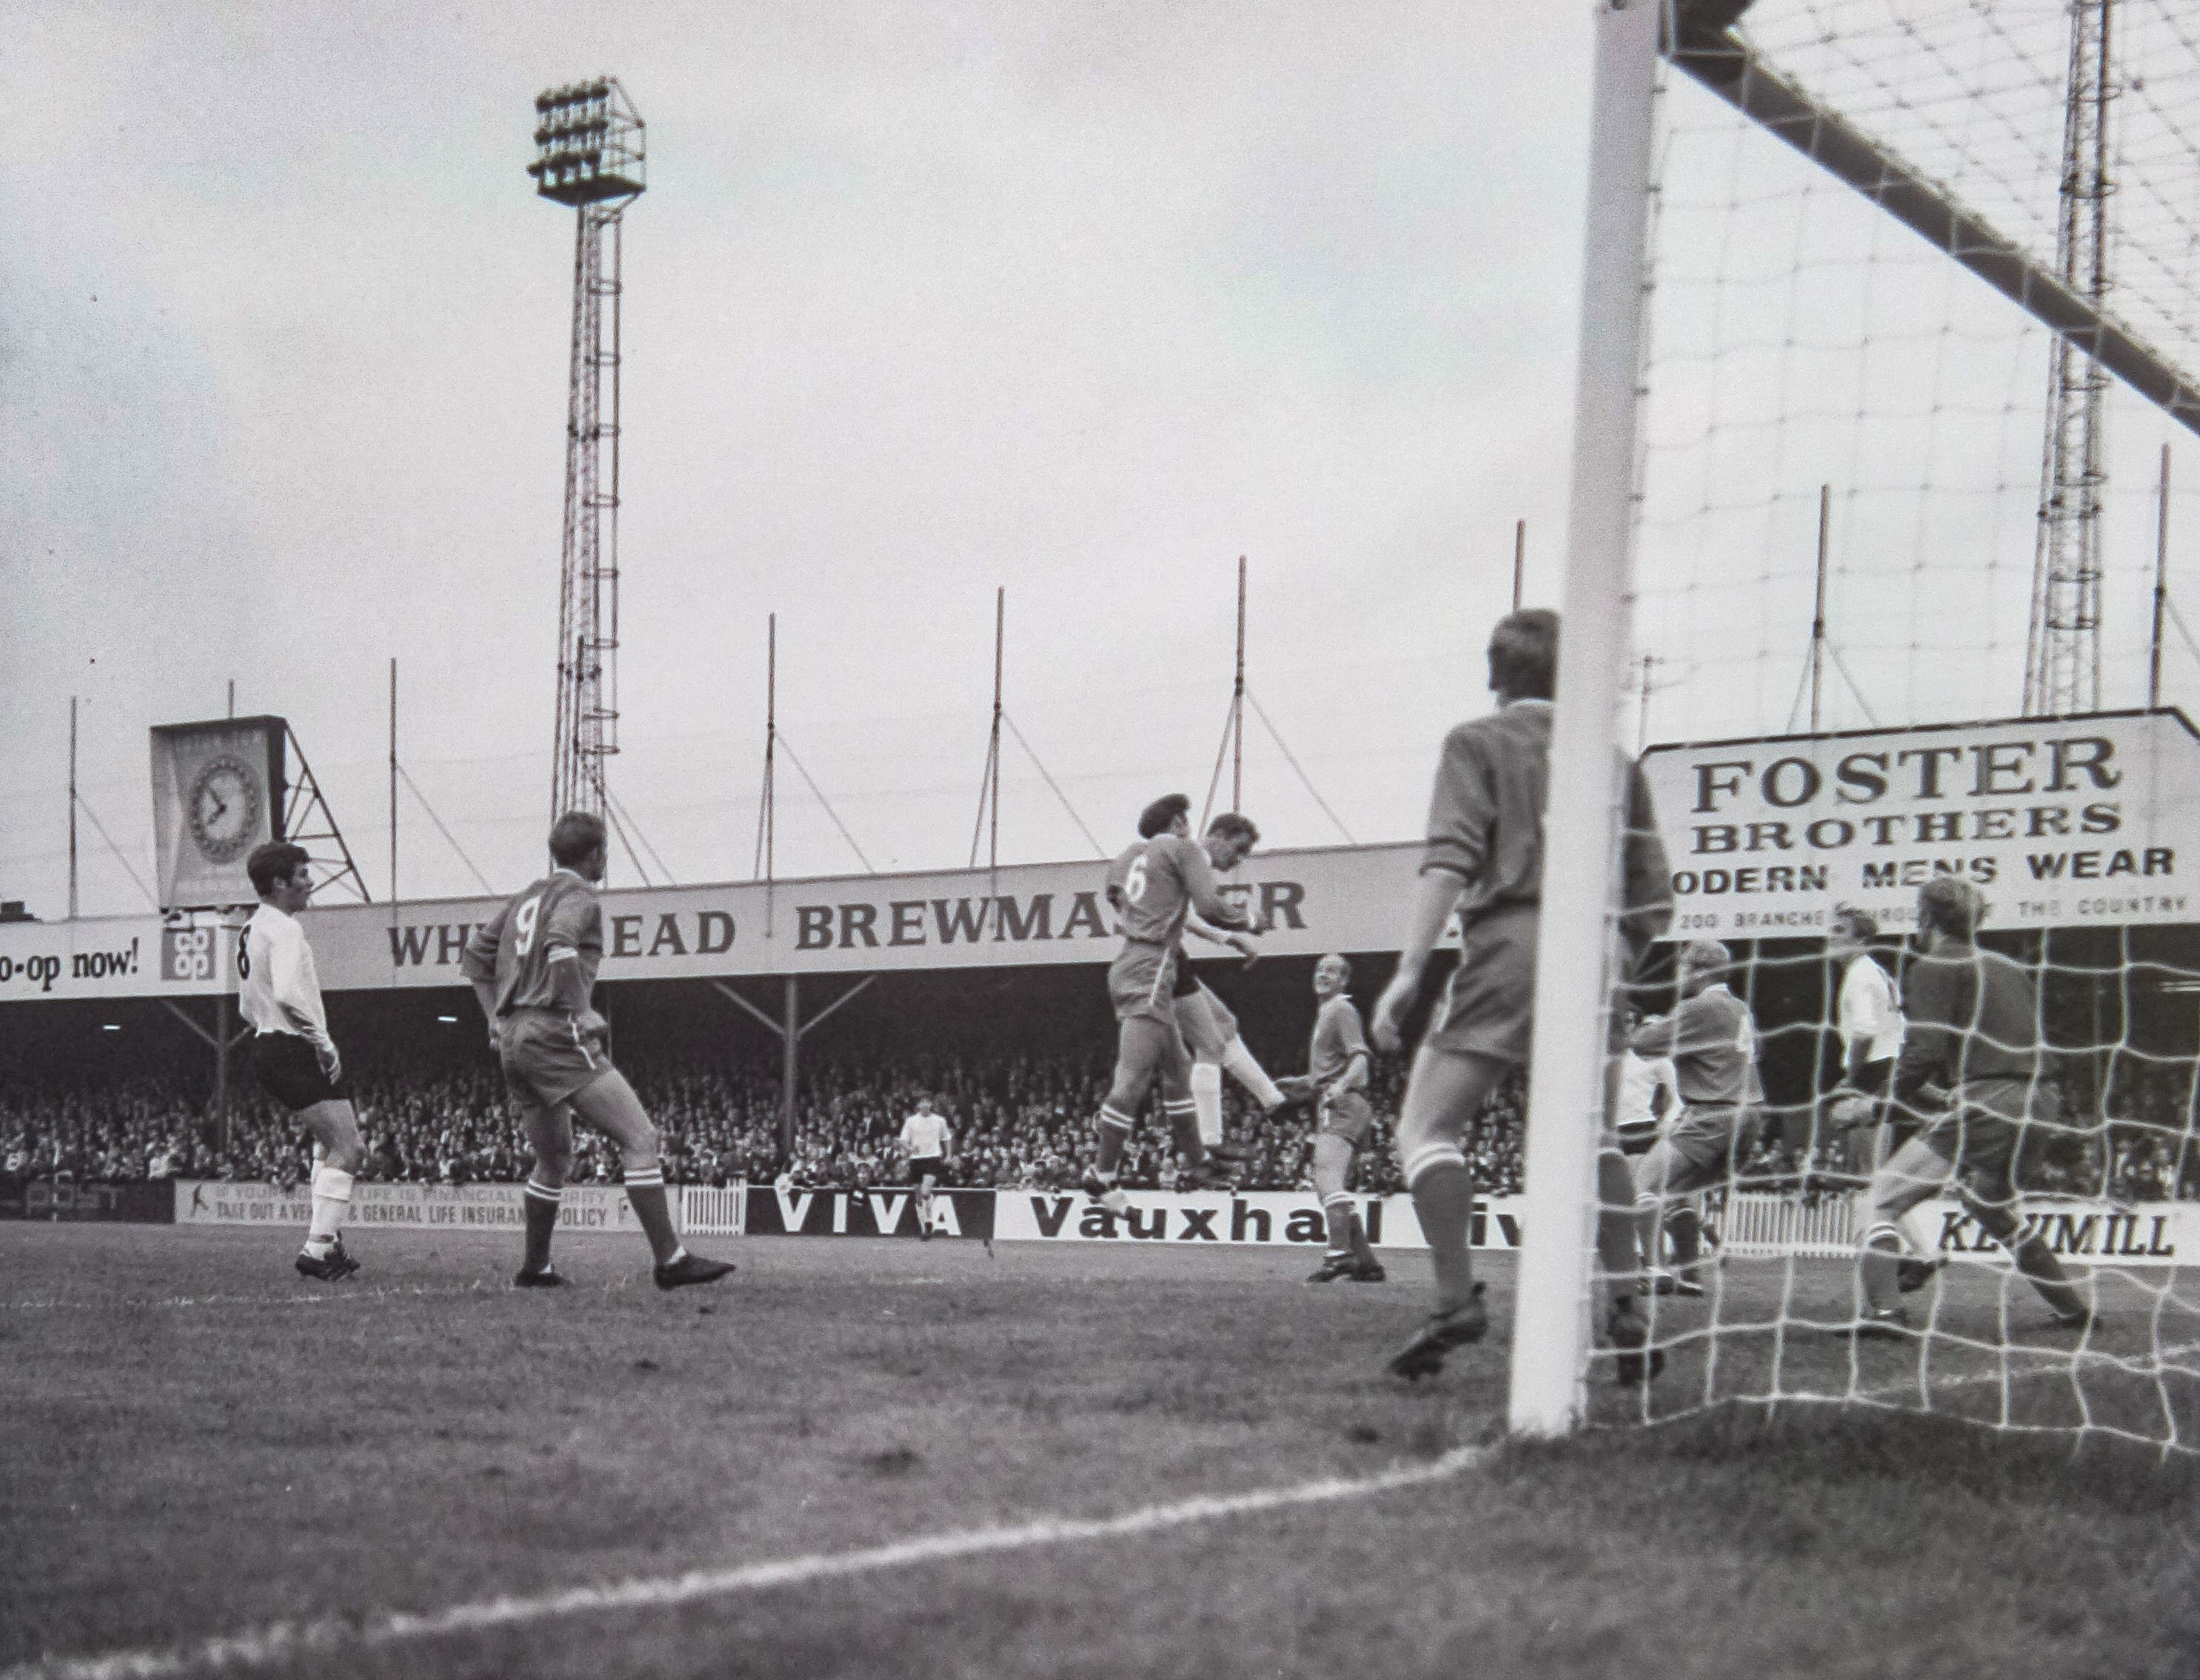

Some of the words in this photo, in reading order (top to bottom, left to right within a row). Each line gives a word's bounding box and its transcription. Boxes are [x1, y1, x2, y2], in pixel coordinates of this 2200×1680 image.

[1691, 737, 2123, 814] FOSTER
[1691, 803, 2122, 854] BROTHERS
[1126, 854, 1148, 903] 6
[1671, 863, 1828, 894] ODERN
[2026, 848, 2176, 880] WEAR
[515, 895, 541, 955] 9
[72, 937, 139, 979] now!
[236, 924, 252, 980] 8
[777, 1191, 961, 1236] VIVA
[1030, 1196, 1382, 1244] Vauxhal
